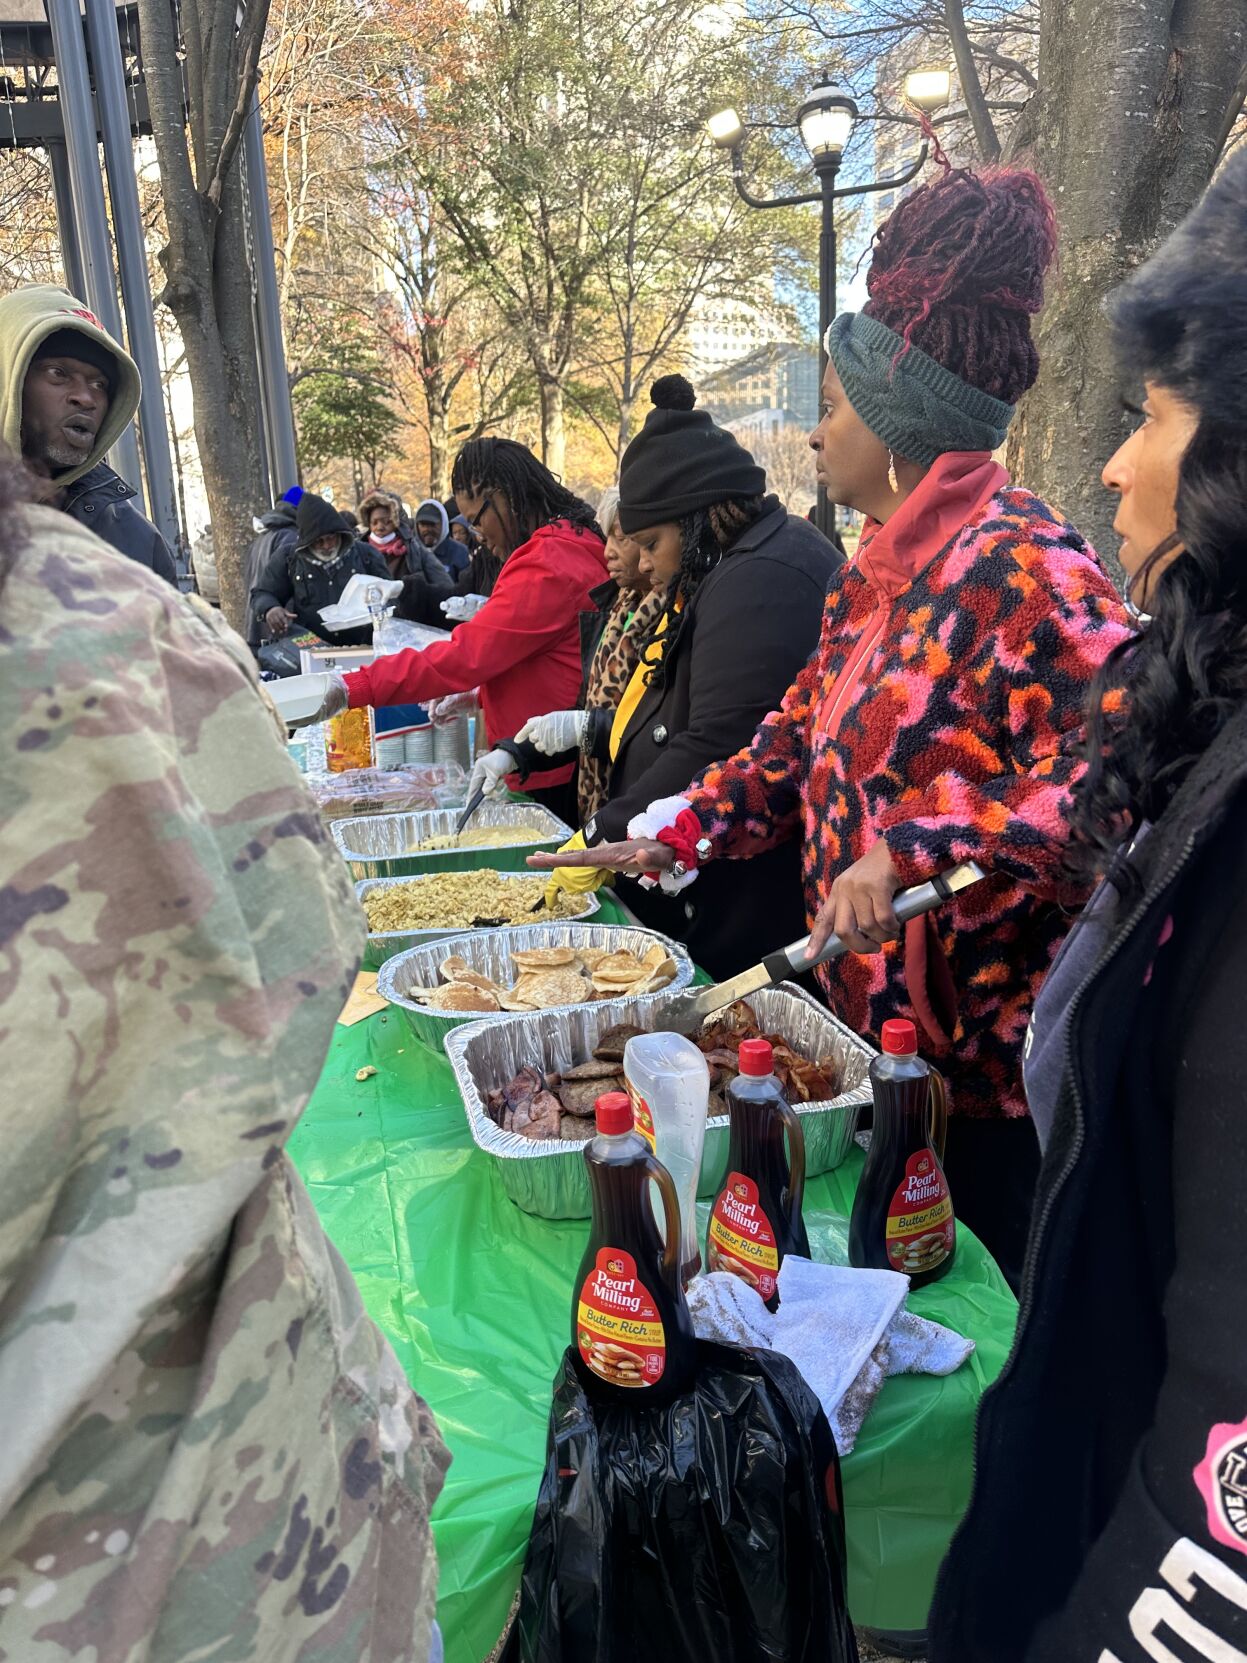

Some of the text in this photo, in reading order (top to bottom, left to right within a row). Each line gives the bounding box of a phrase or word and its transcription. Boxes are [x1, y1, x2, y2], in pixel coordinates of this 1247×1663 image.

[908, 1169, 936, 1190] Pearl
[726, 1190, 757, 1217] Pearl
[902, 1182, 940, 1203] Milling
[721, 1200, 760, 1235] Milling
[898, 1212, 927, 1228] Butter
[929, 1204, 945, 1219] Rich
[715, 1223, 739, 1245] Butter
[740, 1239, 764, 1257] Rich
[597, 1270, 635, 1293] Pearl
[591, 1281, 641, 1312] Milling
[600, 1301, 629, 1311] COMPANY
[586, 1309, 618, 1329] Butter
[619, 1320, 648, 1336] Rich
